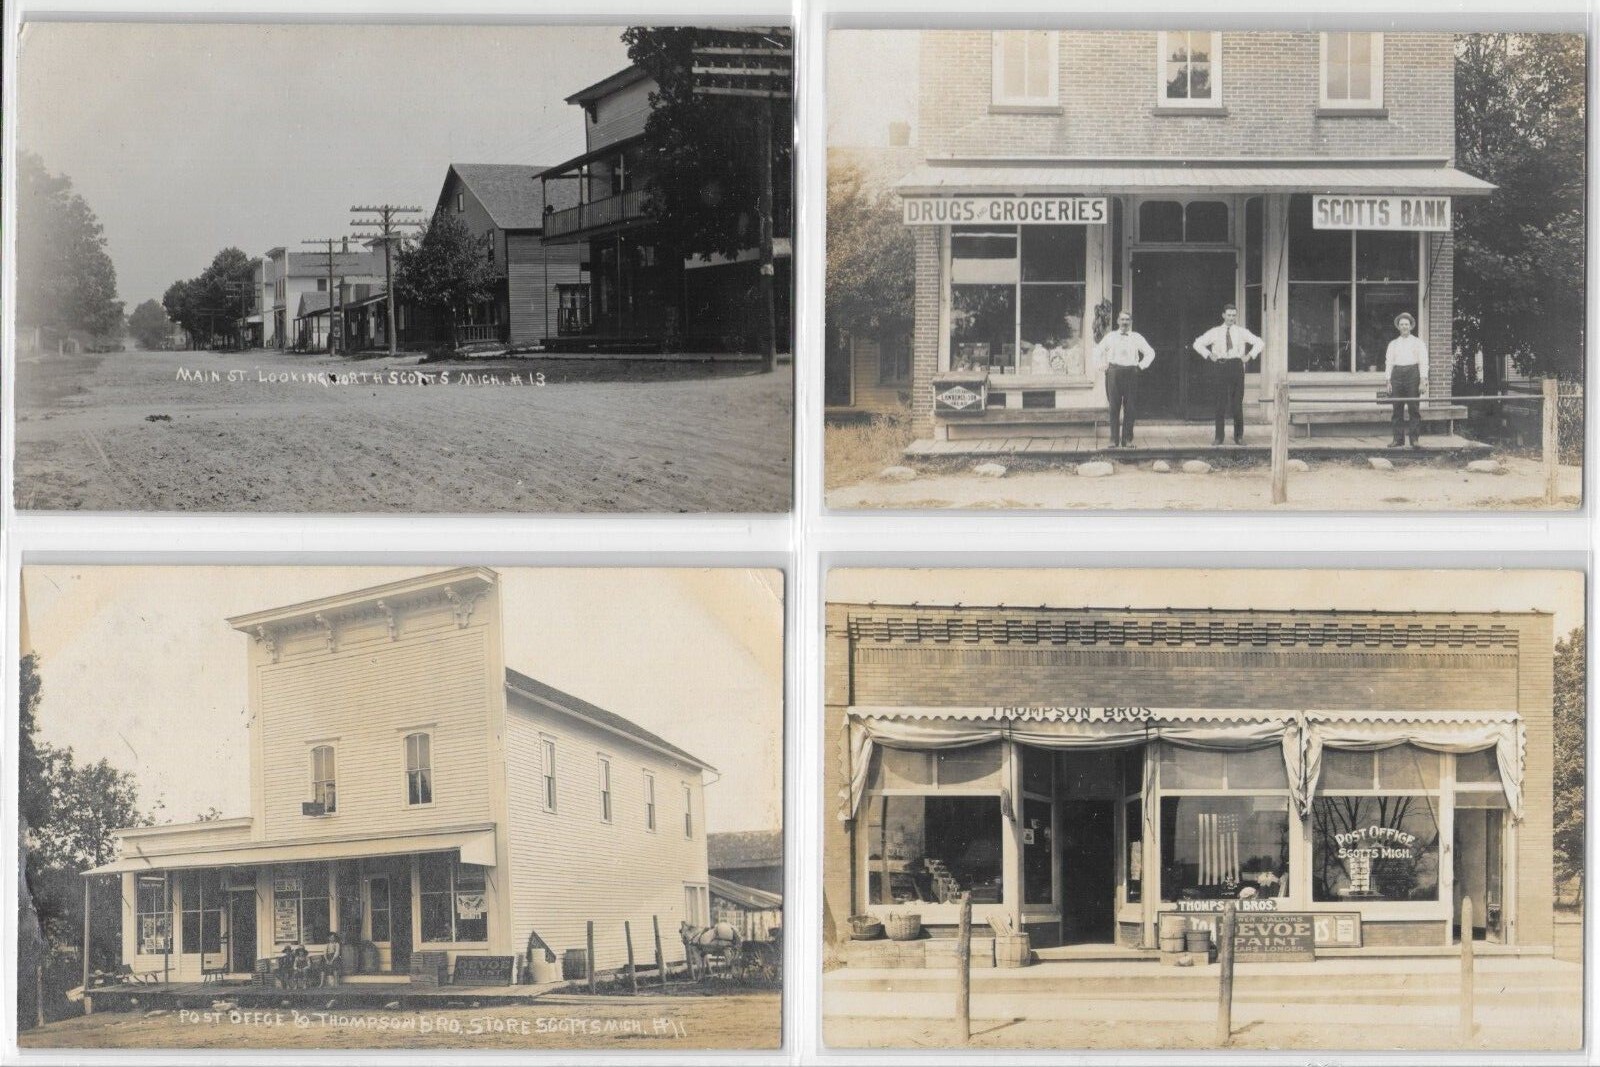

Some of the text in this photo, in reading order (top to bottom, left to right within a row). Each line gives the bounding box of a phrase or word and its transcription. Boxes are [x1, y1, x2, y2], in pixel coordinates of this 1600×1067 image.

[907, 201, 975, 222] DRUGS
[989, 200, 1104, 222] GROCERIES
[1317, 198, 1447, 227] SCOTTS BANK
[992, 707, 1157, 719] THOMPSON BROS.
[1334, 825, 1416, 848] POST OFFICE
[1337, 847, 1413, 860] SCOTTS MICH.
[1179, 900, 1279, 912] THOMPSN BROS.
[1234, 937, 1300, 946] PAINT
